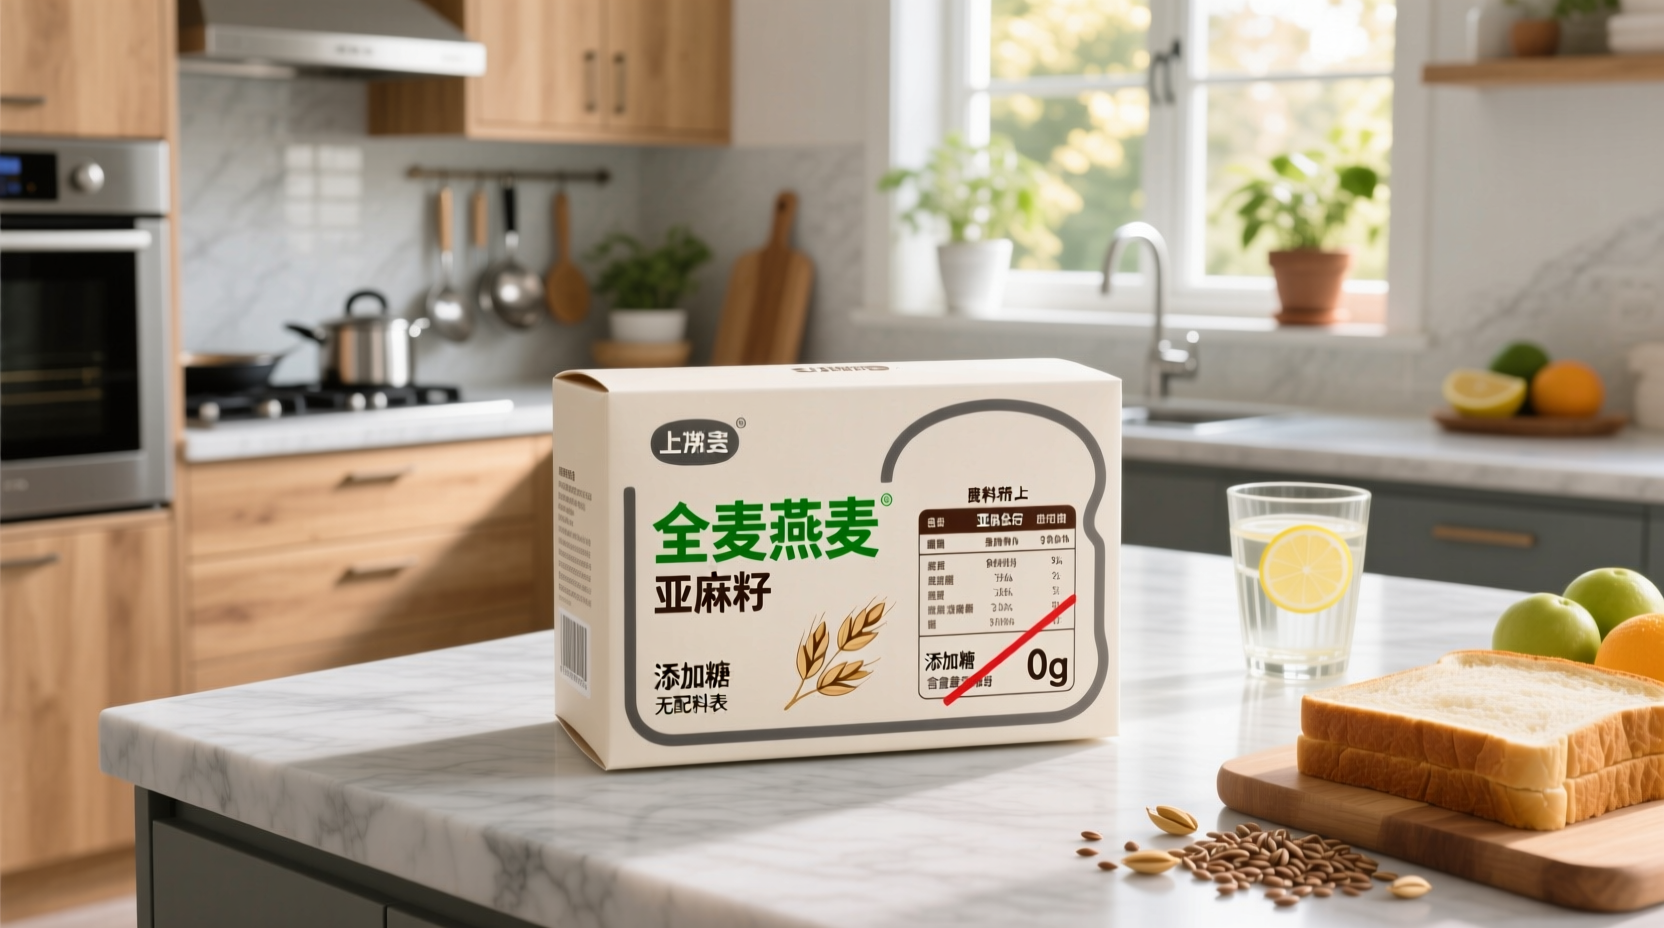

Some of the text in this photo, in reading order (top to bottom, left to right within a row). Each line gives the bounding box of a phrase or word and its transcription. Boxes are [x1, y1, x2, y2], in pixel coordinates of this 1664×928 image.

[652, 496, 879, 564] 全麦燕麦
[654, 571, 772, 614] 亚麻籽
[654, 660, 731, 691] 添加糖
[924, 650, 975, 672] 添加糖
[1027, 648, 1068, 688] 0g
[655, 693, 728, 716] 无配料表
